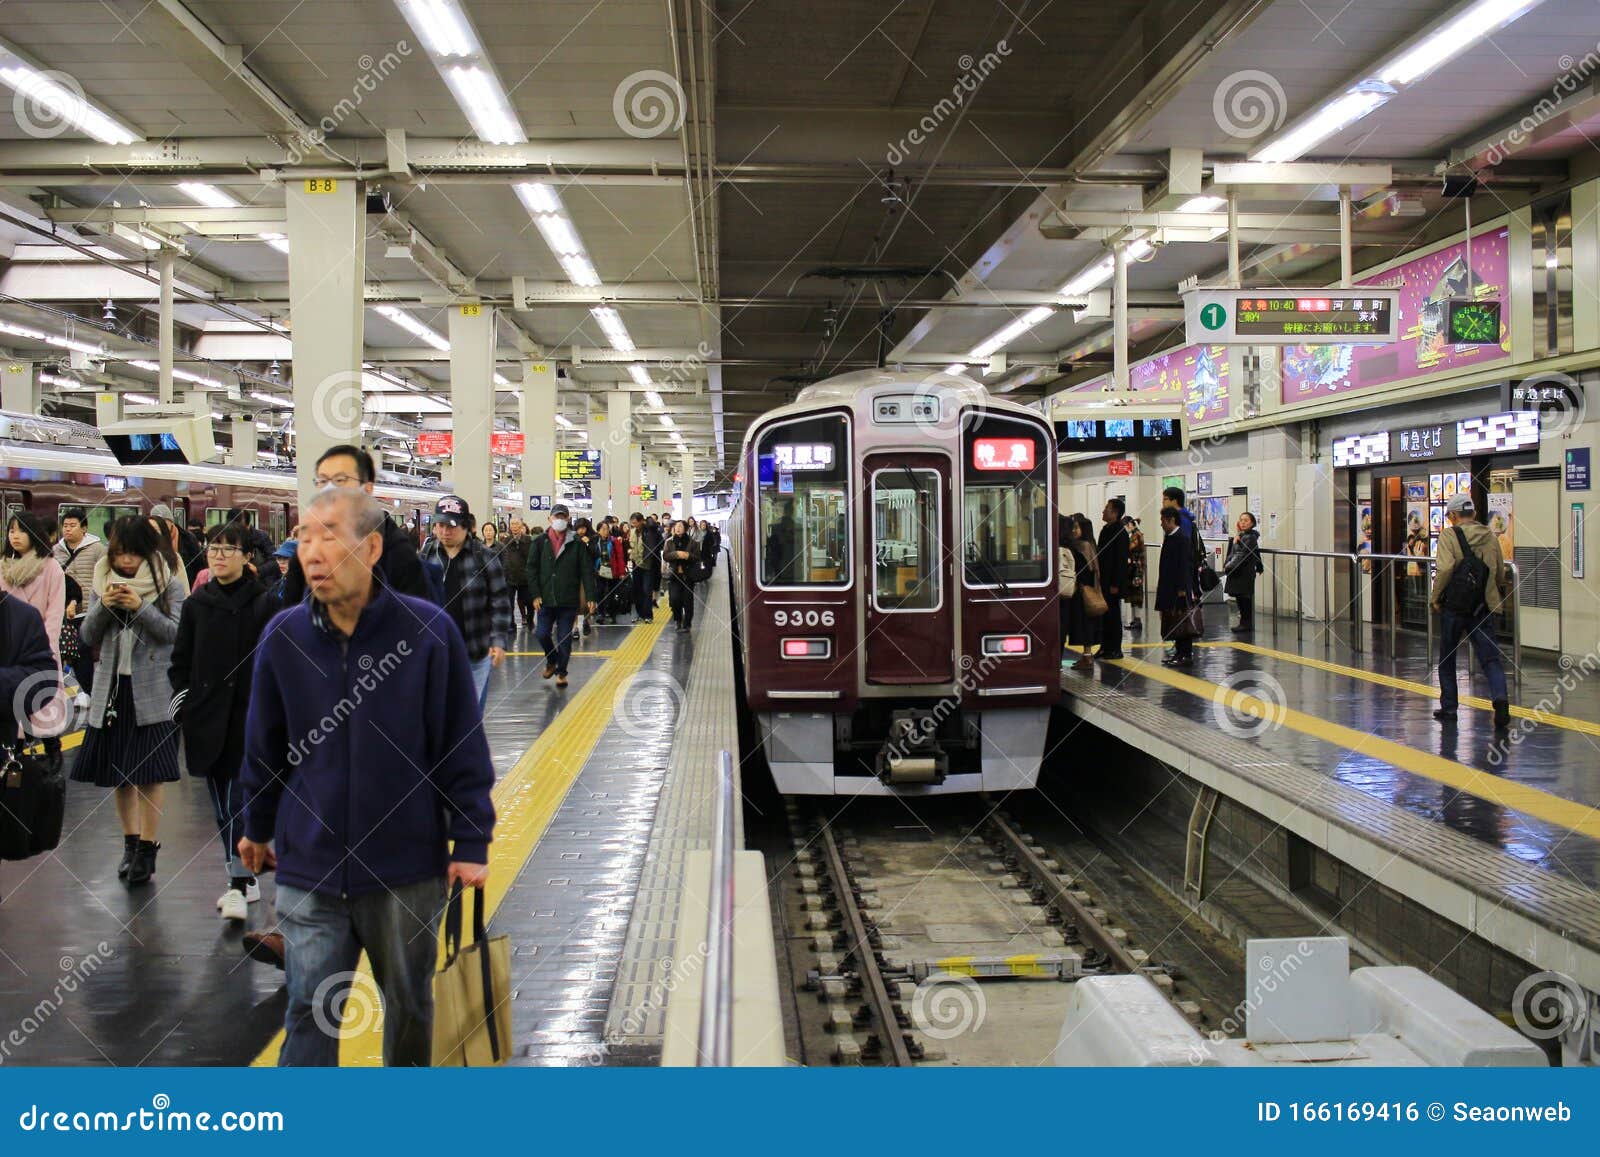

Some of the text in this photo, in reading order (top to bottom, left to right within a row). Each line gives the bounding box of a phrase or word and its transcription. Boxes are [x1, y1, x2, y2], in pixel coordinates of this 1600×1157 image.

[310, 179, 332, 191] B-8
[463, 305, 478, 315] B-9
[1269, 300, 1295, 310] 10:40
[1207, 307, 1217, 326] 1
[1513, 387, 1564, 399] 阪急そば
[1400, 427, 1442, 452] 阪急そば
[774, 610, 835, 627] 9306
